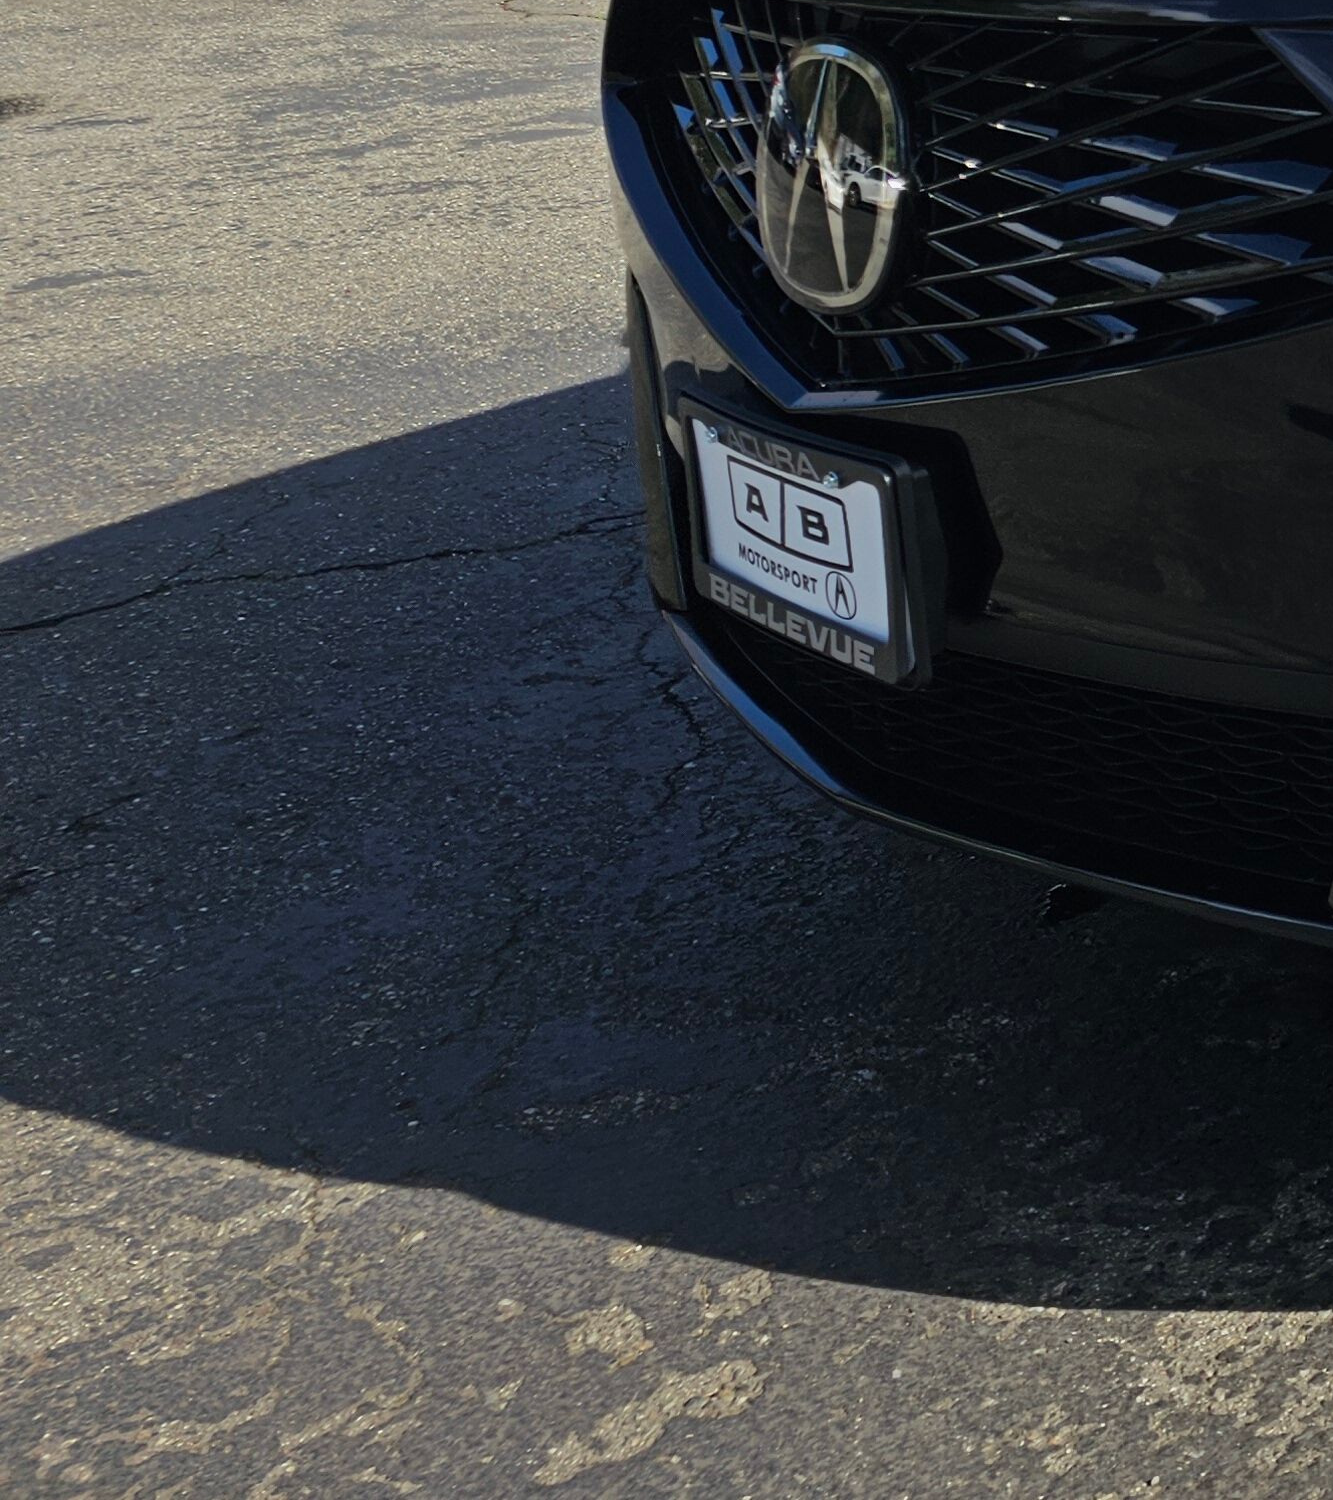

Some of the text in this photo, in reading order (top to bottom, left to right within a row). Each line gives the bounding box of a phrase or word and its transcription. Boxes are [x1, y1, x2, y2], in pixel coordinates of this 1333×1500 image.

[727, 426, 821, 481] ACURA
[738, 543, 818, 595] MOTORSPORT
[709, 573, 876, 676] BELLEVUE
